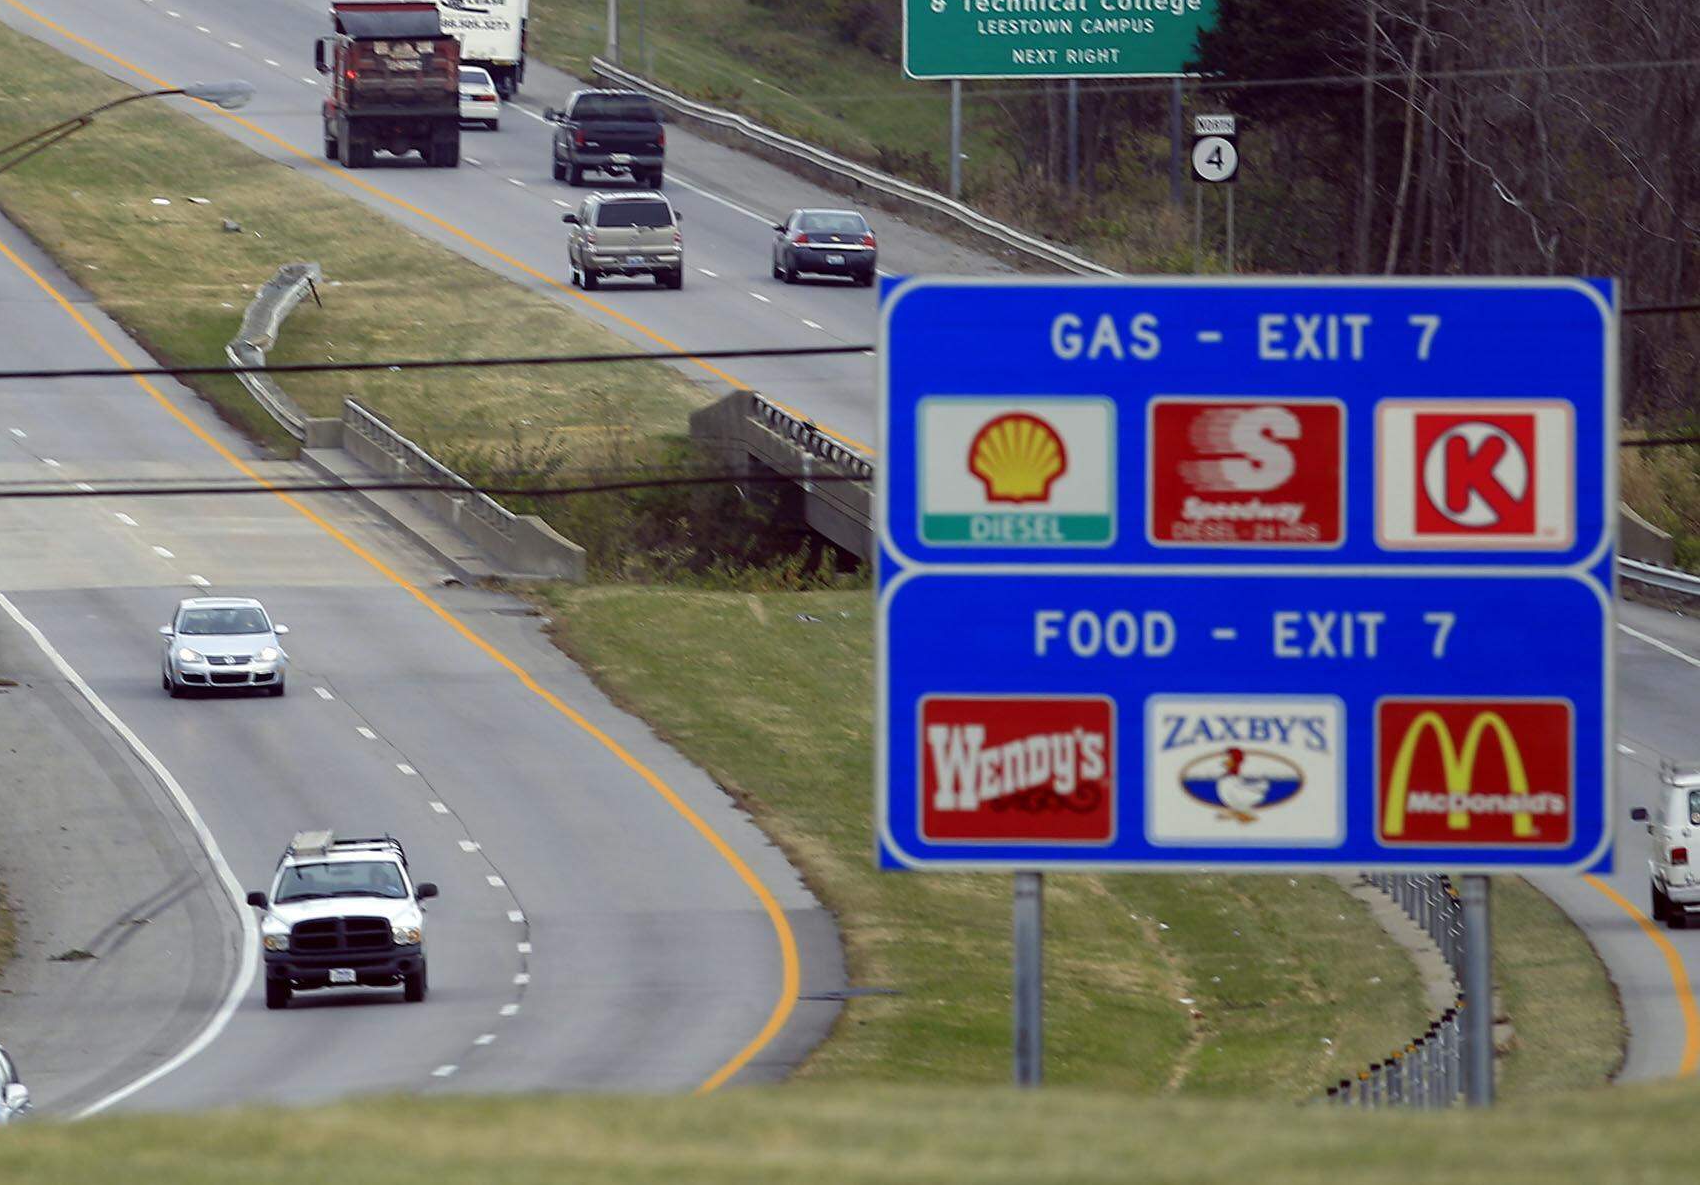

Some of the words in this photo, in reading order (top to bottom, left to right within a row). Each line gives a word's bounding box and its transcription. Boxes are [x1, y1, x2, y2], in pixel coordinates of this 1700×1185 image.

[977, 19, 1073, 34] LEESTOWN
[1080, 17, 1155, 33] CAMPUS
[1011, 48, 1058, 64] NEXT
[1065, 48, 1120, 64] RIGHT
[1204, 145, 1225, 171] 4
[1050, 313, 1161, 361] GAS
[1196, 330, 1222, 343] -
[1258, 313, 1371, 360] EXIT
[1408, 314, 1441, 361] 7
[1179, 496, 1305, 524] Speedway
[970, 515, 1064, 540] DIESEL
[1034, 610, 1177, 658] FOOD
[1211, 627, 1236, 640] -
[1273, 611, 1385, 658] EXIT
[1423, 612, 1456, 658] 7
[1161, 714, 1330, 752] ZAXBY'S
[1406, 791, 1567, 815] McDonald's
